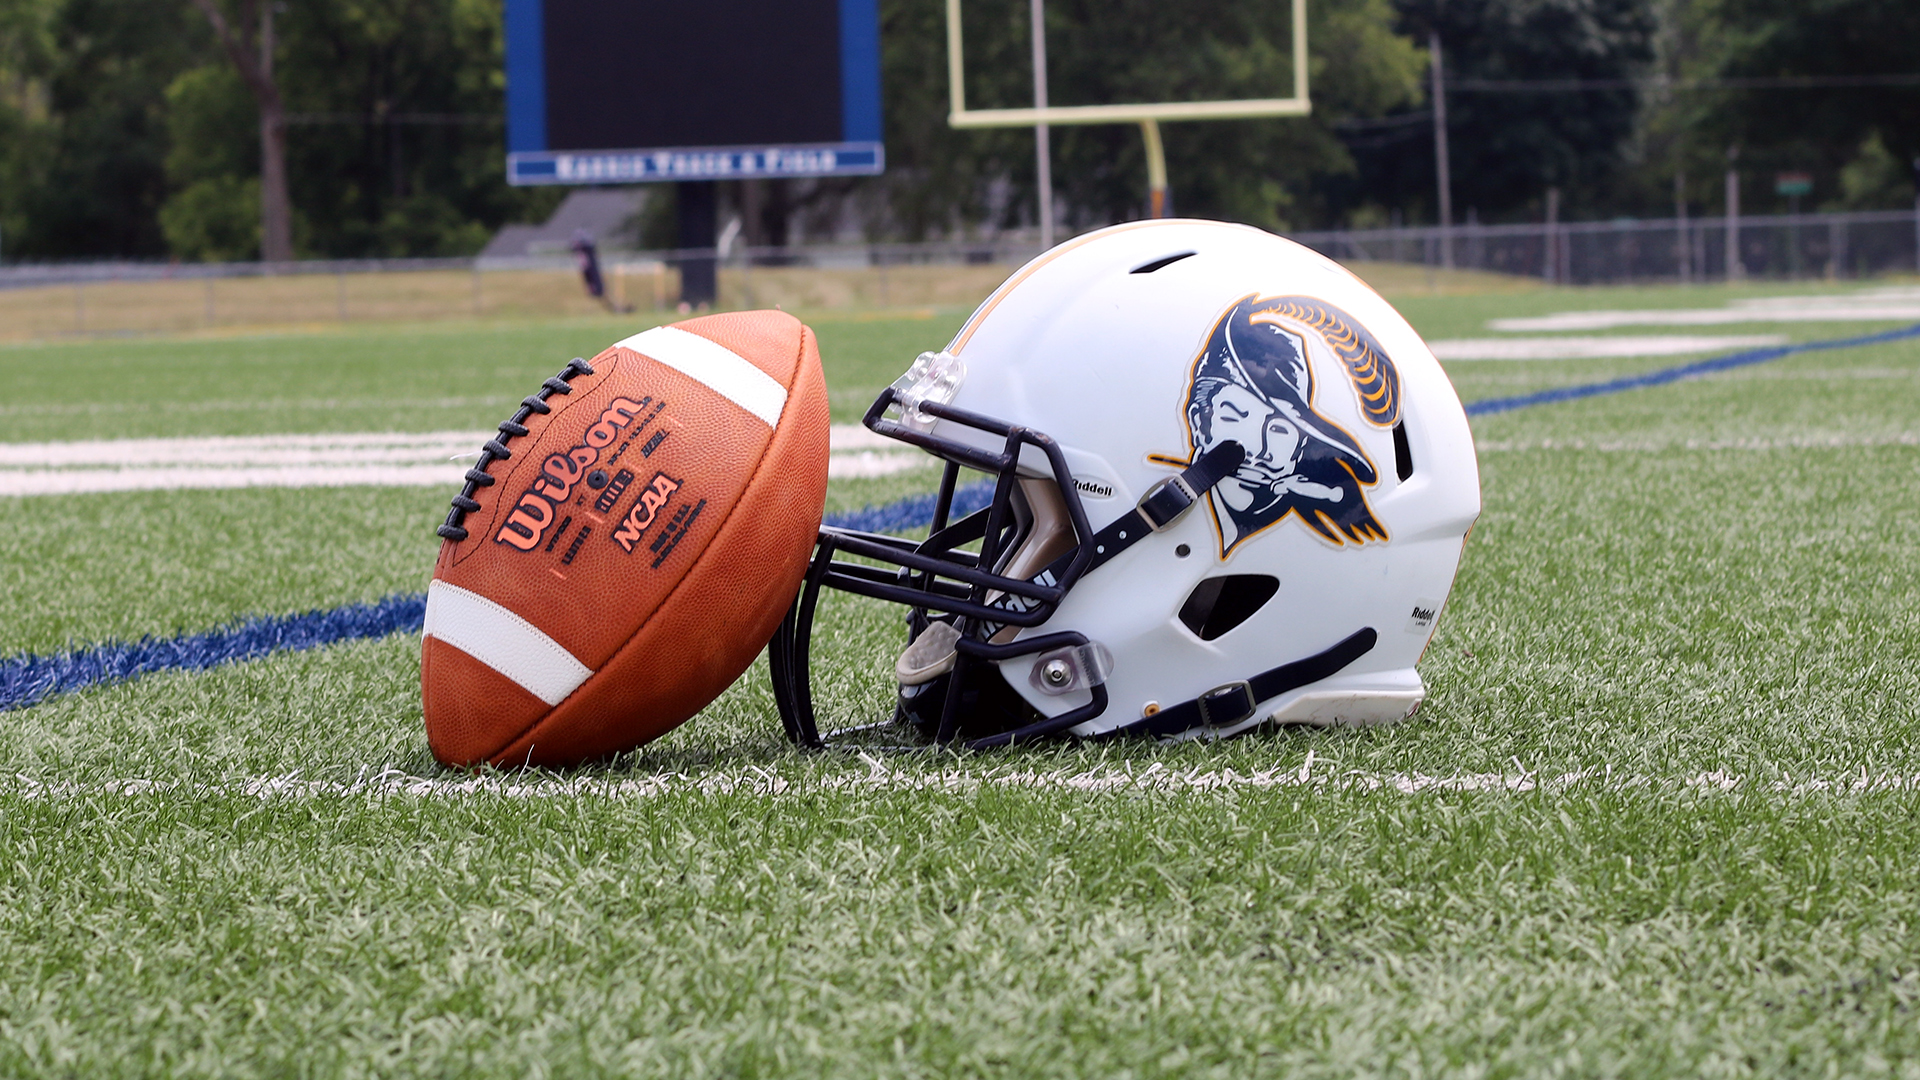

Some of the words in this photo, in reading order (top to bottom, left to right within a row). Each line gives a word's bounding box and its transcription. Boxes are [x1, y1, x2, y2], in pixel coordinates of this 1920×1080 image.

[493, 396, 645, 552] Wilson
[610, 471, 680, 554] NCAA
[561, 525, 592, 565] LEATHER
